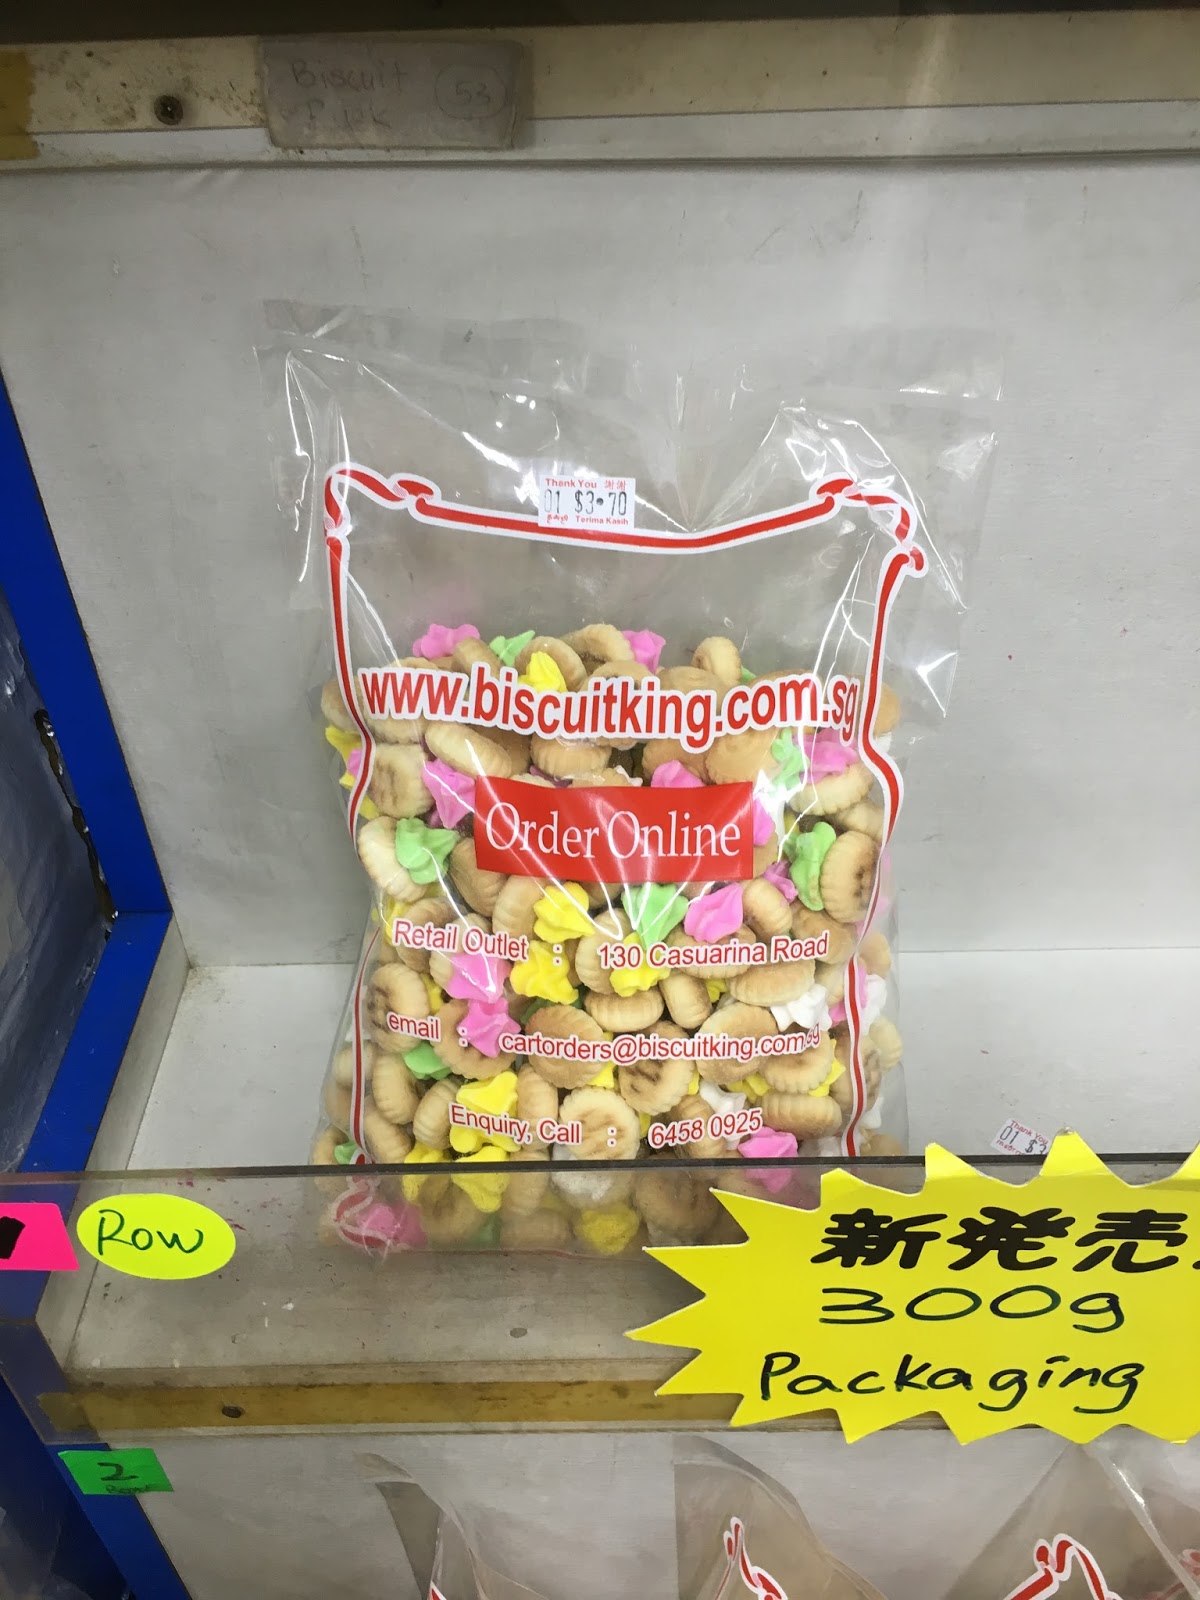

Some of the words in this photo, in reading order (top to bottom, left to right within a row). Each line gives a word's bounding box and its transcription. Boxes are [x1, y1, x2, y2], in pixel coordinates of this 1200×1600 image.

[544, 489, 560, 514] 01
[545, 478, 576, 488] Thank
[578, 480, 597, 489] You
[575, 515, 604, 524] Terima
[605, 517, 629, 526] Kasih
[359, 666, 859, 749] www.biscuitking.com.sg
[485, 802, 600, 859] Order
[607, 810, 742, 859] Online
[394, 920, 458, 950] Retail
[465, 928, 528, 960] Outlet
[599, 945, 641, 968] 130
[649, 942, 765, 966] Casuarina
[773, 932, 829, 961] Road
[388, 1013, 440, 1039] email
[451, 1104, 531, 1142] Enquiry,
[539, 1119, 582, 1144] Call
[651, 1118, 704, 1147] 6458
[710, 1109, 762, 1138] 0925
[1010, 1120, 1033, 1137] Thank
[1035, 1132, 1050, 1146] You
[97, 1208, 205, 1256] Row
[810, 1206, 1200, 1274] 新発売
[818, 1284, 1126, 1334] 300g
[760, 1350, 1146, 1414] Packaging
[97, 1462, 139, 1481] 2
